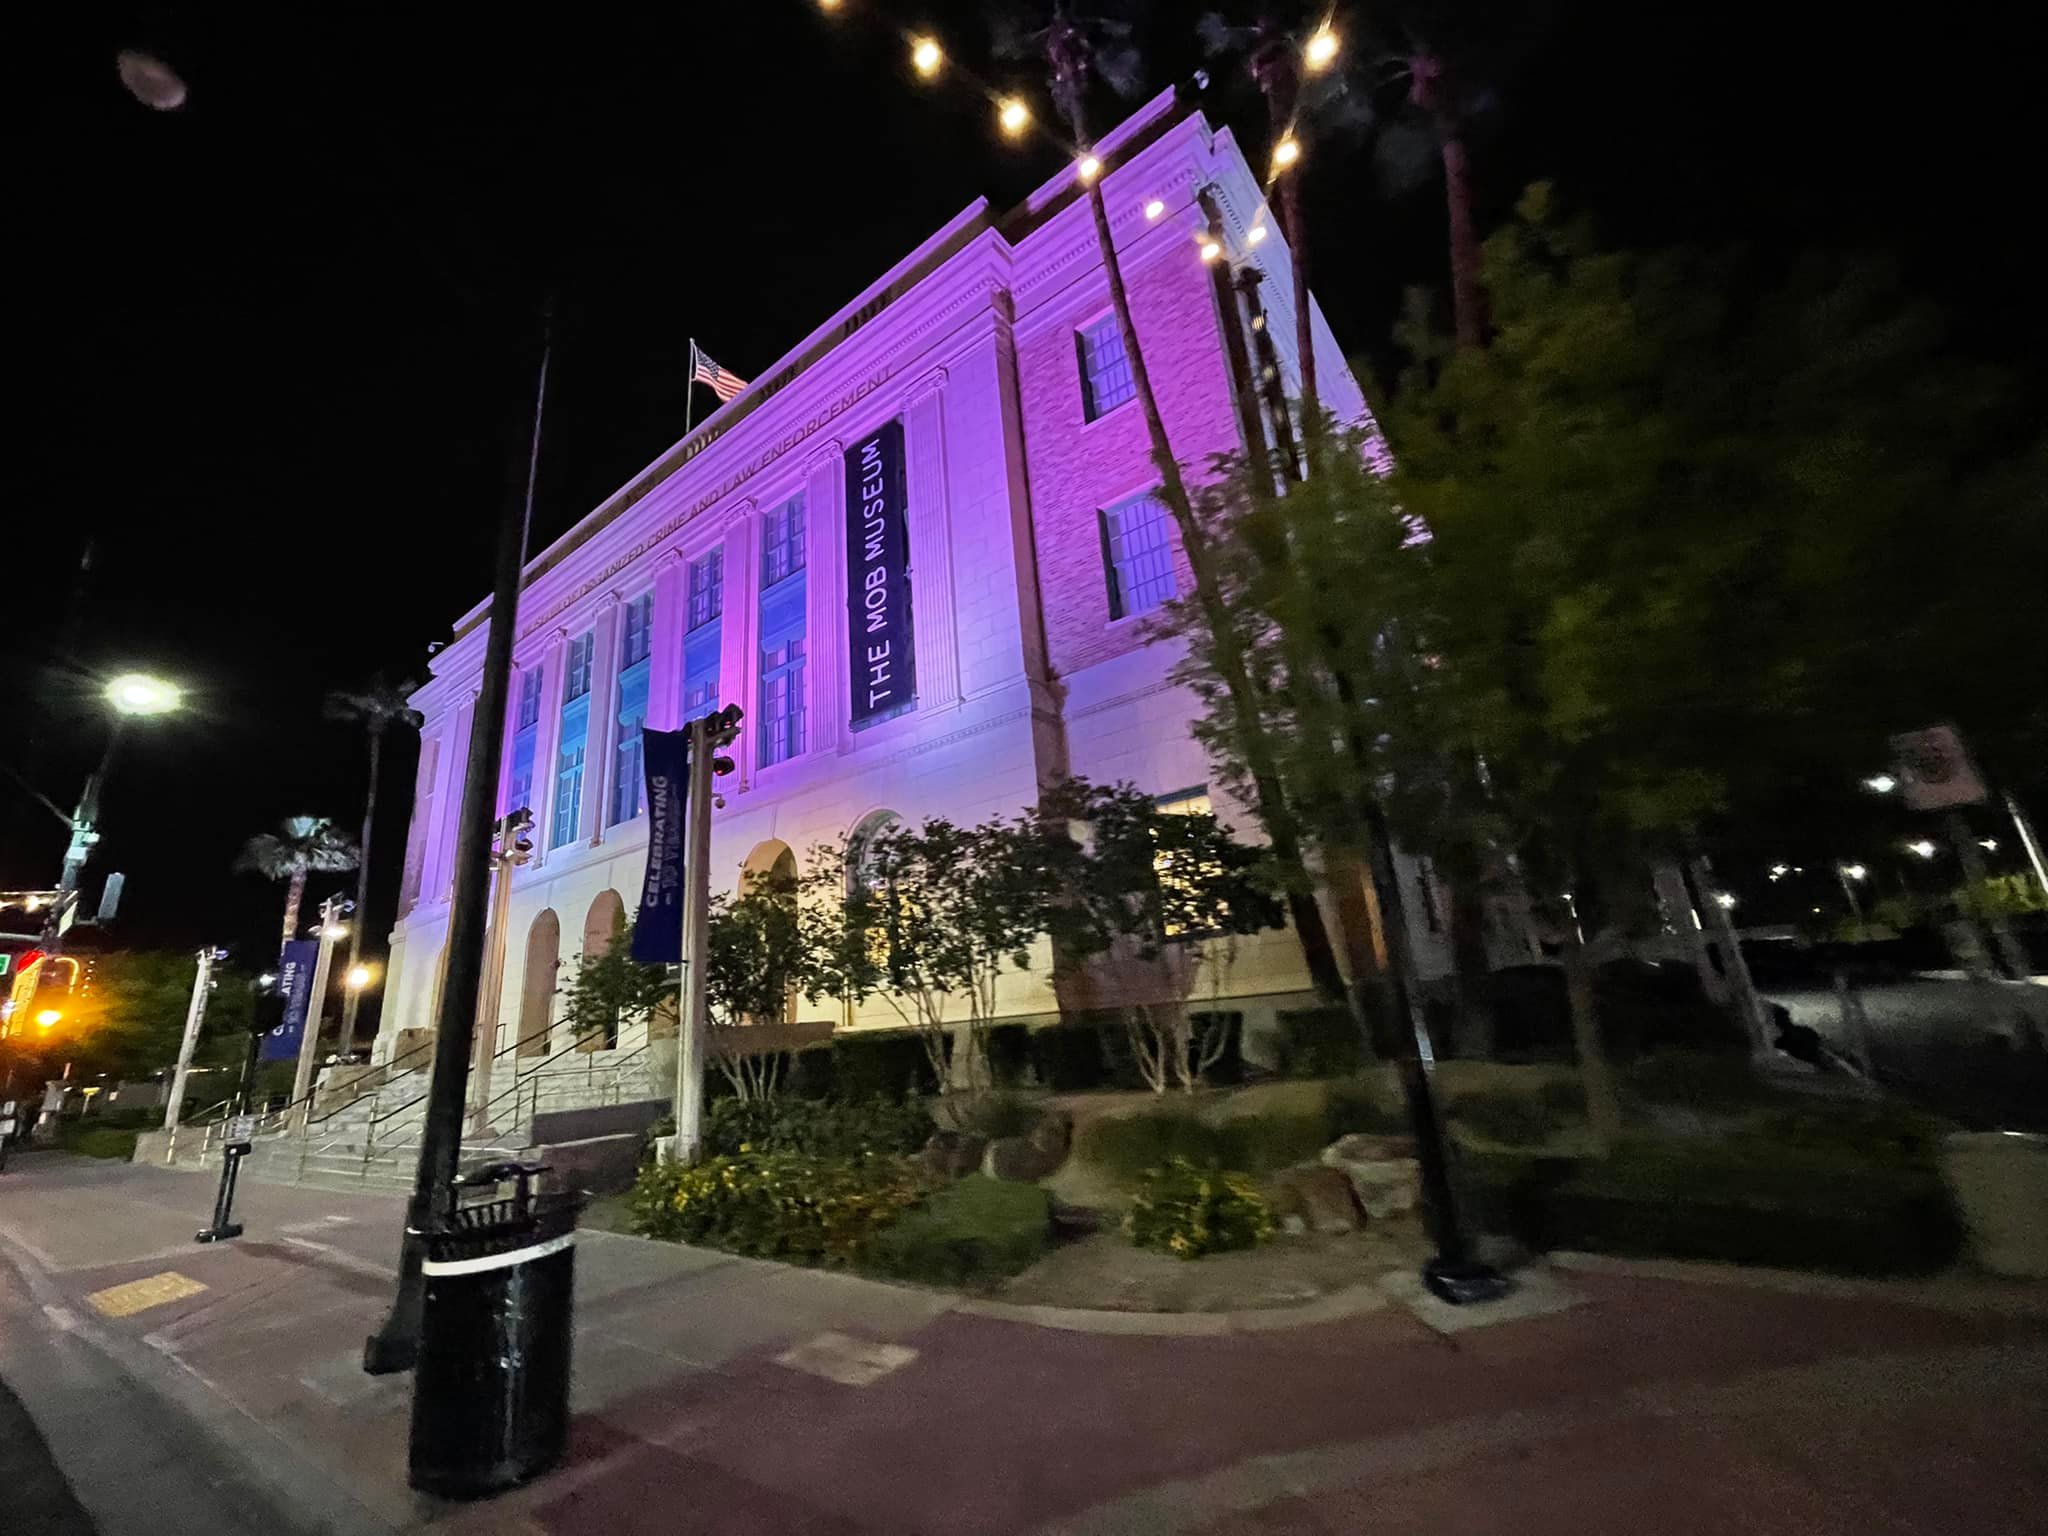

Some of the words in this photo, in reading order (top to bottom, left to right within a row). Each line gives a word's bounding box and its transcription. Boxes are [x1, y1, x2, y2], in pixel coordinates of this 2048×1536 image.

[647, 511, 686, 547] CRIME
[691, 490, 719, 515] AND
[724, 461, 758, 494] LAW
[761, 363, 892, 466] ENFORCEMENT
[861, 438, 885, 561] MUSEUM
[865, 566, 888, 633] MOB
[868, 639, 891, 709] THE
[646, 775, 669, 908] CELEBRATING
